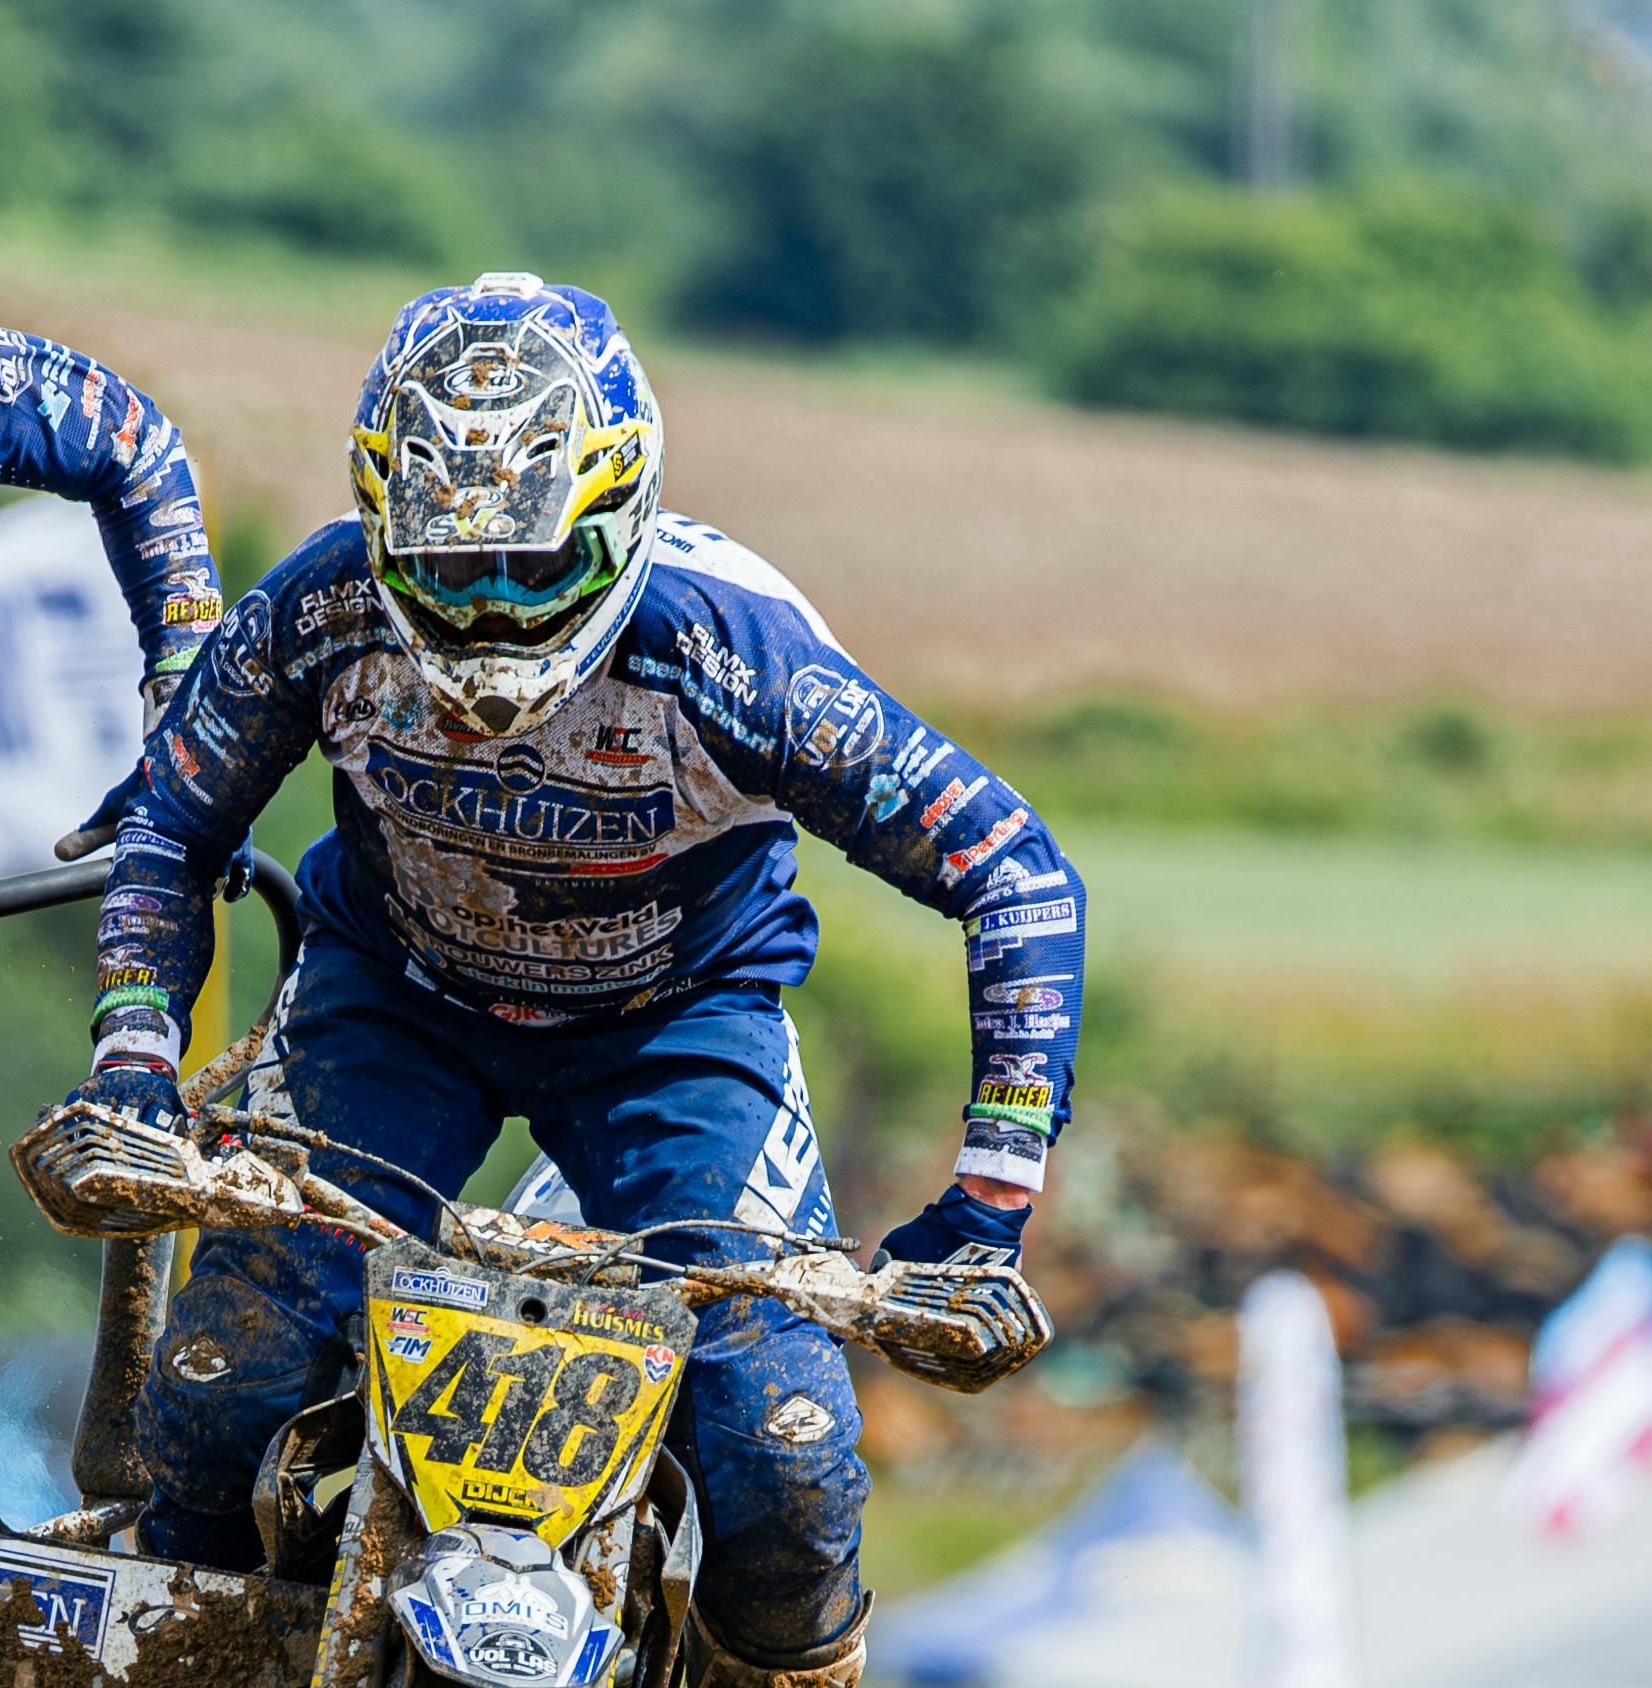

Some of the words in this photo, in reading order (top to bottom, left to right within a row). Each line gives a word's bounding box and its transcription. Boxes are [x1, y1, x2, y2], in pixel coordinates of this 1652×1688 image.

[165, 598, 223, 625] REIGER
[295, 595, 384, 636] DESIGN
[676, 630, 758, 707] DESIGN
[692, 622, 756, 685] RLMX
[379, 766, 658, 845] OCKHUIZEN
[572, 902, 657, 939] Veld
[595, 943, 675, 980] ZINK
[980, 1083, 1050, 1109] REIGER
[399, 1275, 482, 1300] OCKHUIZEN
[389, 1335, 432, 1358] FIM
[391, 1328, 642, 1488] 418
[469, 1648, 511, 1663] VOL
[517, 1651, 558, 1675] LAS
